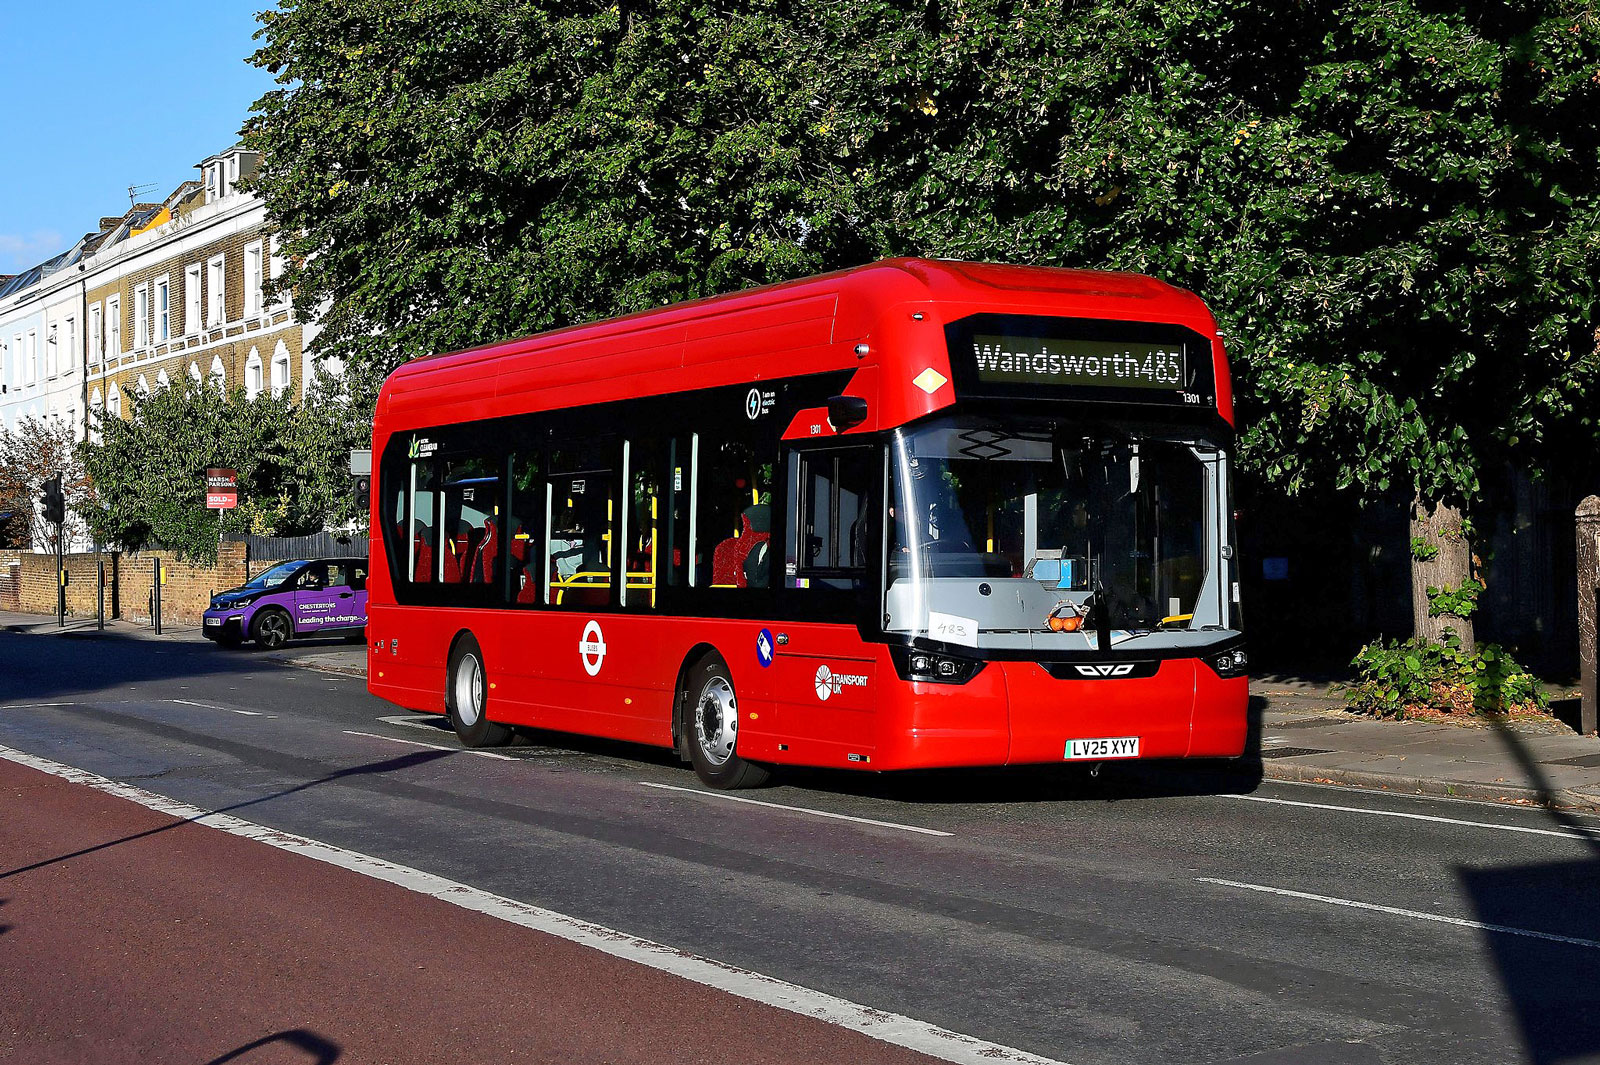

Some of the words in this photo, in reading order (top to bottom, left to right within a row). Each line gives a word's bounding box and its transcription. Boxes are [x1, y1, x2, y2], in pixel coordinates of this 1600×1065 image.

[973, 343, 1140, 378] Wandsworth
[1140, 350, 1180, 384] 485
[1182, 392, 1200, 405] 1301
[810, 424, 821, 435] 1301
[298, 602, 336, 610] CHESTERTONS
[298, 616, 324, 624] Leading
[324, 615, 335, 623] the
[336, 614, 358, 623] charge
[831, 673, 868, 687] TRANSPORT
[832, 684, 842, 694] UK
[1073, 740, 1108, 756] LV25
[1111, 739, 1137, 754] XYY
